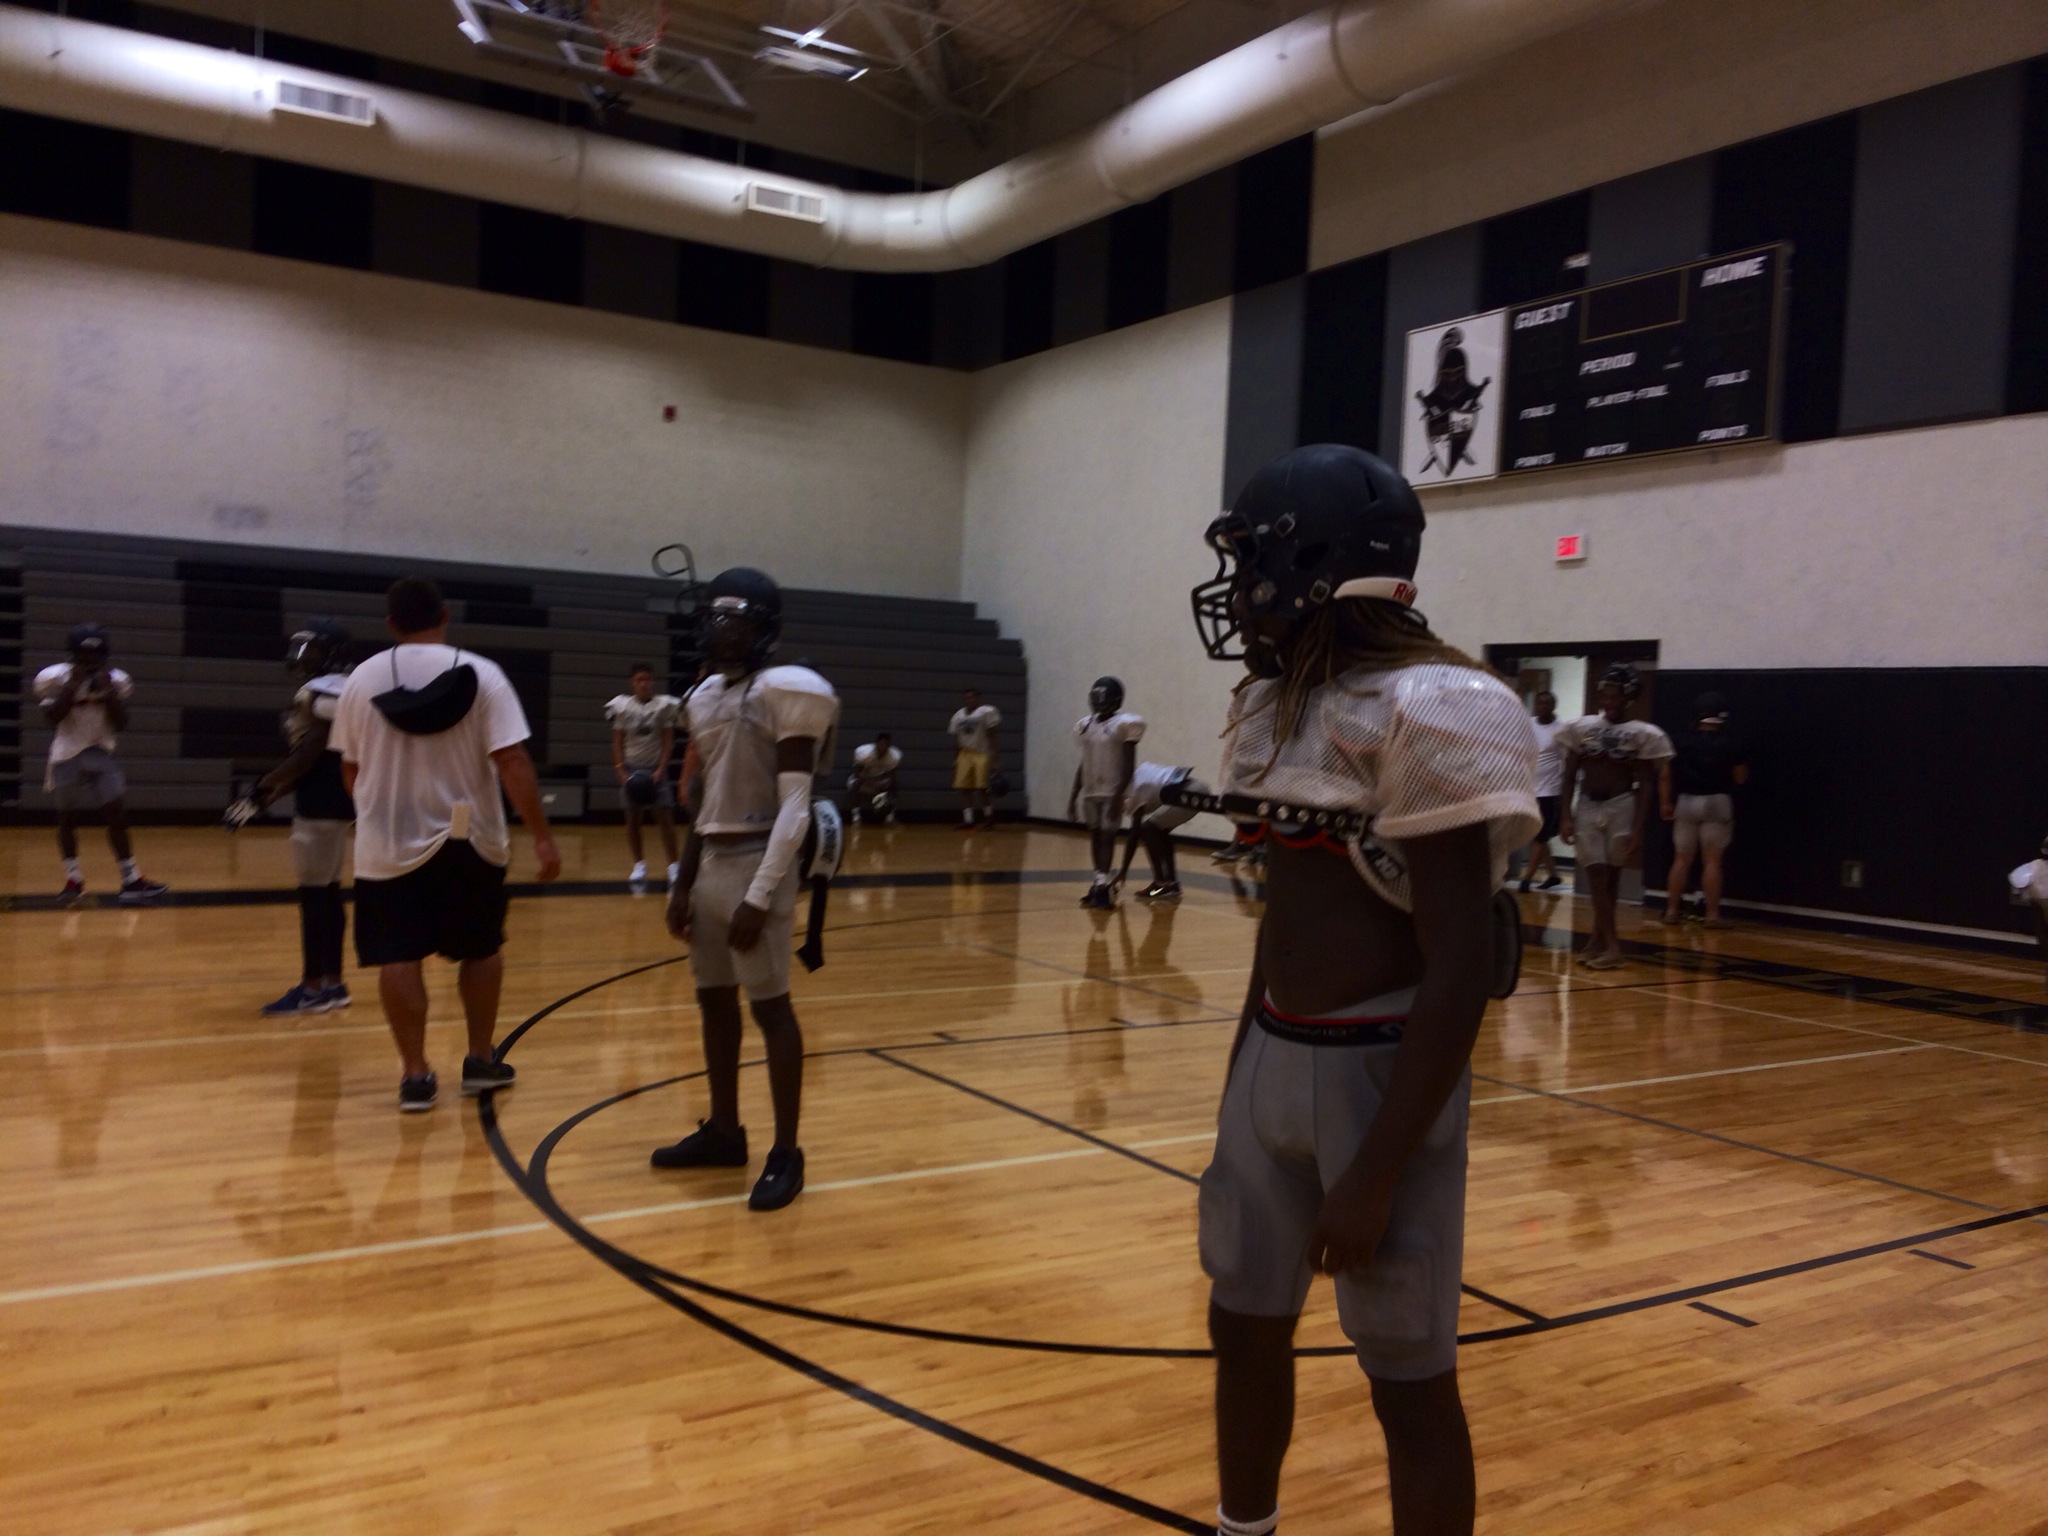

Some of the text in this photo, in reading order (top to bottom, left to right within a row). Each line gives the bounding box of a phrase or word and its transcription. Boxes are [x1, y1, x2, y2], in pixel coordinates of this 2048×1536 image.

[1700, 255, 1768, 287] HOME
[1514, 301, 1575, 330] GUEST
[1579, 351, 1638, 376] PERIOD
[1704, 369, 1751, 388] FOULS
[1697, 424, 1749, 442] POINTS
[1513, 452, 1556, 469] POINTS
